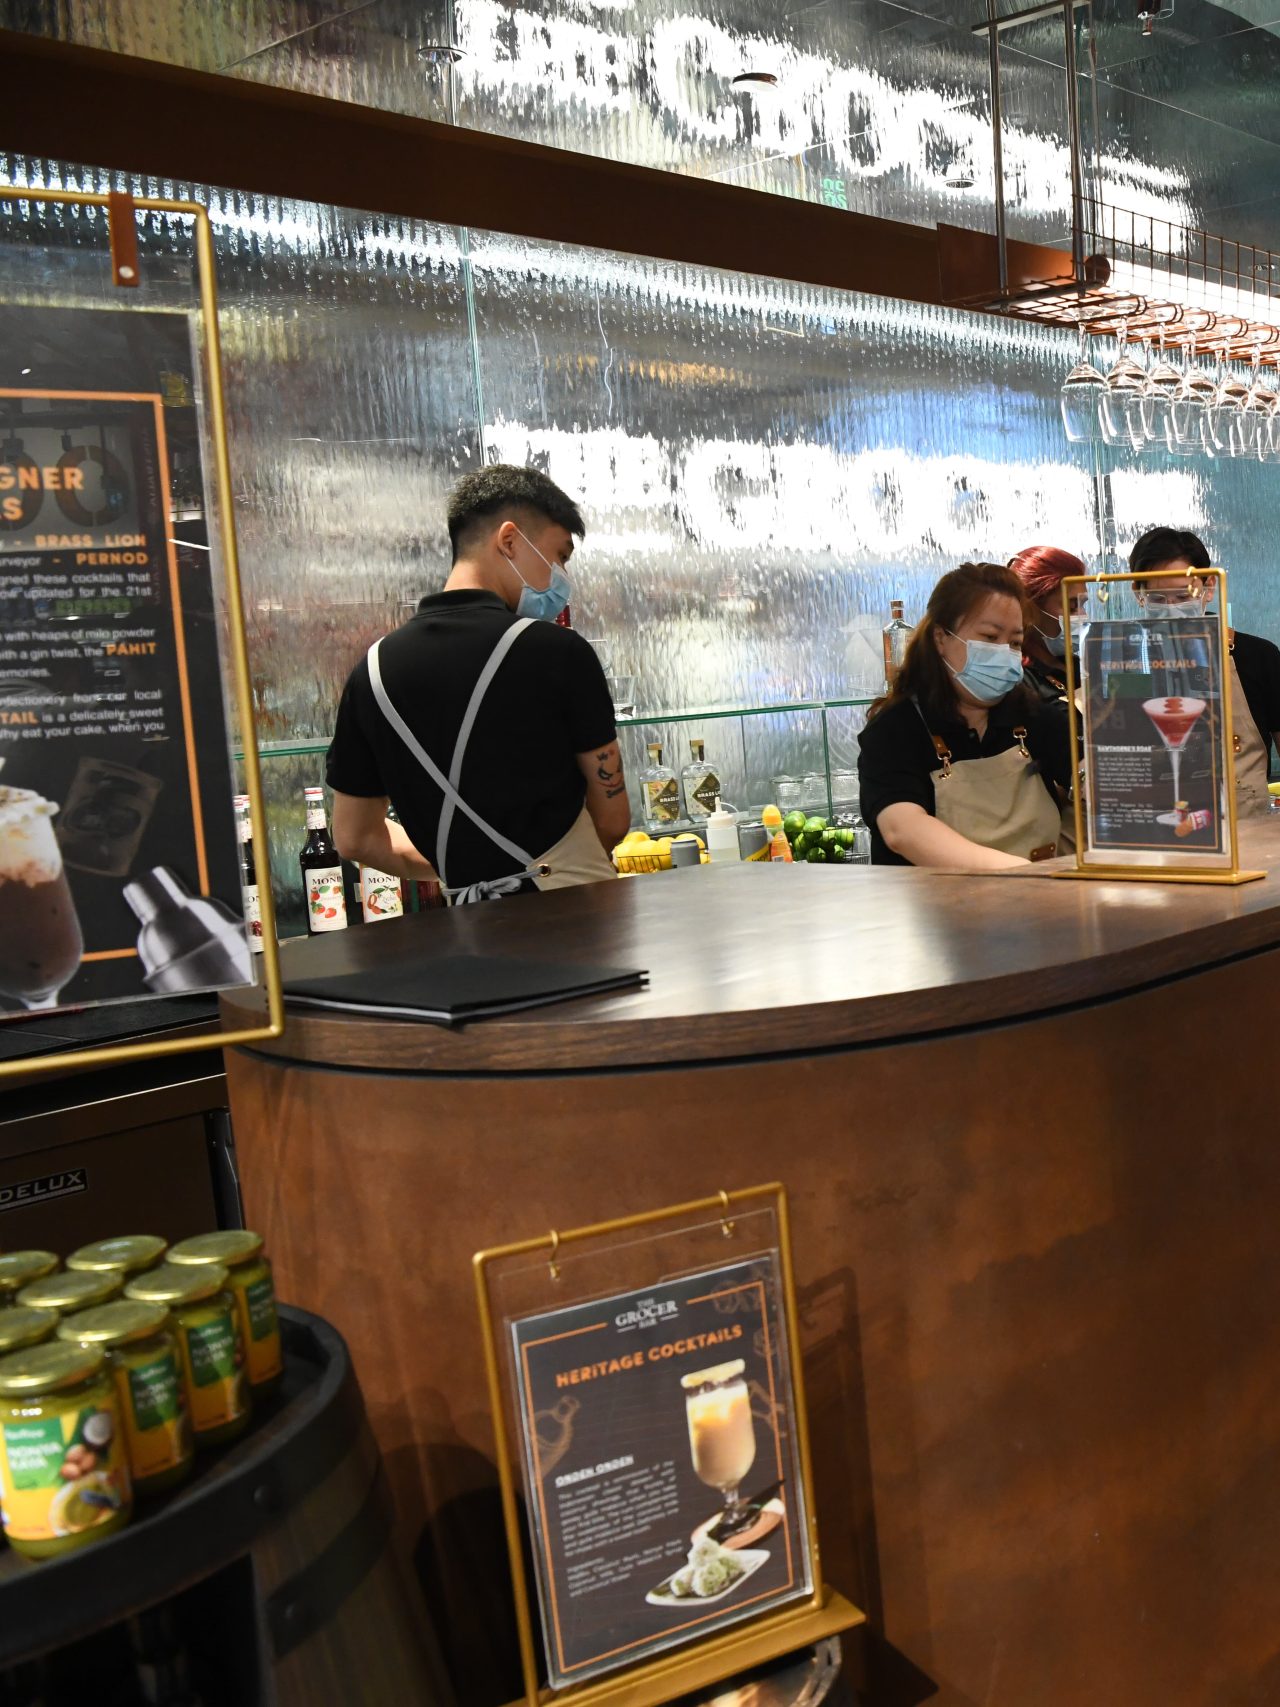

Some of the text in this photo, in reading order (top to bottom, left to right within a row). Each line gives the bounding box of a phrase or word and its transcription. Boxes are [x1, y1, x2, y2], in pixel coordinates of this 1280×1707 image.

[34, 534, 93, 548] BRASS
[105, 534, 146, 548] LION
[76, 552, 148, 565] PERNOD
[34, 573, 67, 584] these
[72, 572, 123, 583] cocktails
[128, 571, 150, 582] that
[79, 586, 94, 597] for
[101, 585, 118, 596] the
[126, 585, 151, 596] 21st
[5, 627, 155, 641] with heaps of milo powder
[20, 651, 28, 659] a
[30, 649, 48, 661] gin
[84, 646, 103, 657] the
[106, 642, 157, 656] PAHIT
[134, 689, 162, 699] local
[42, 713, 53, 723] is
[57, 713, 66, 722] a
[70, 709, 124, 721] delicately
[129, 707, 163, 719] sweet
[22, 728, 42, 738] eat
[45, 727, 70, 739] your
[109, 722, 141, 733] when
[143, 723, 165, 733] you
[0, 1172, 82, 1203] DELUX
[615, 1300, 678, 1327] GROCER
[556, 1324, 743, 1387] HERITAGE COCKTAILS
